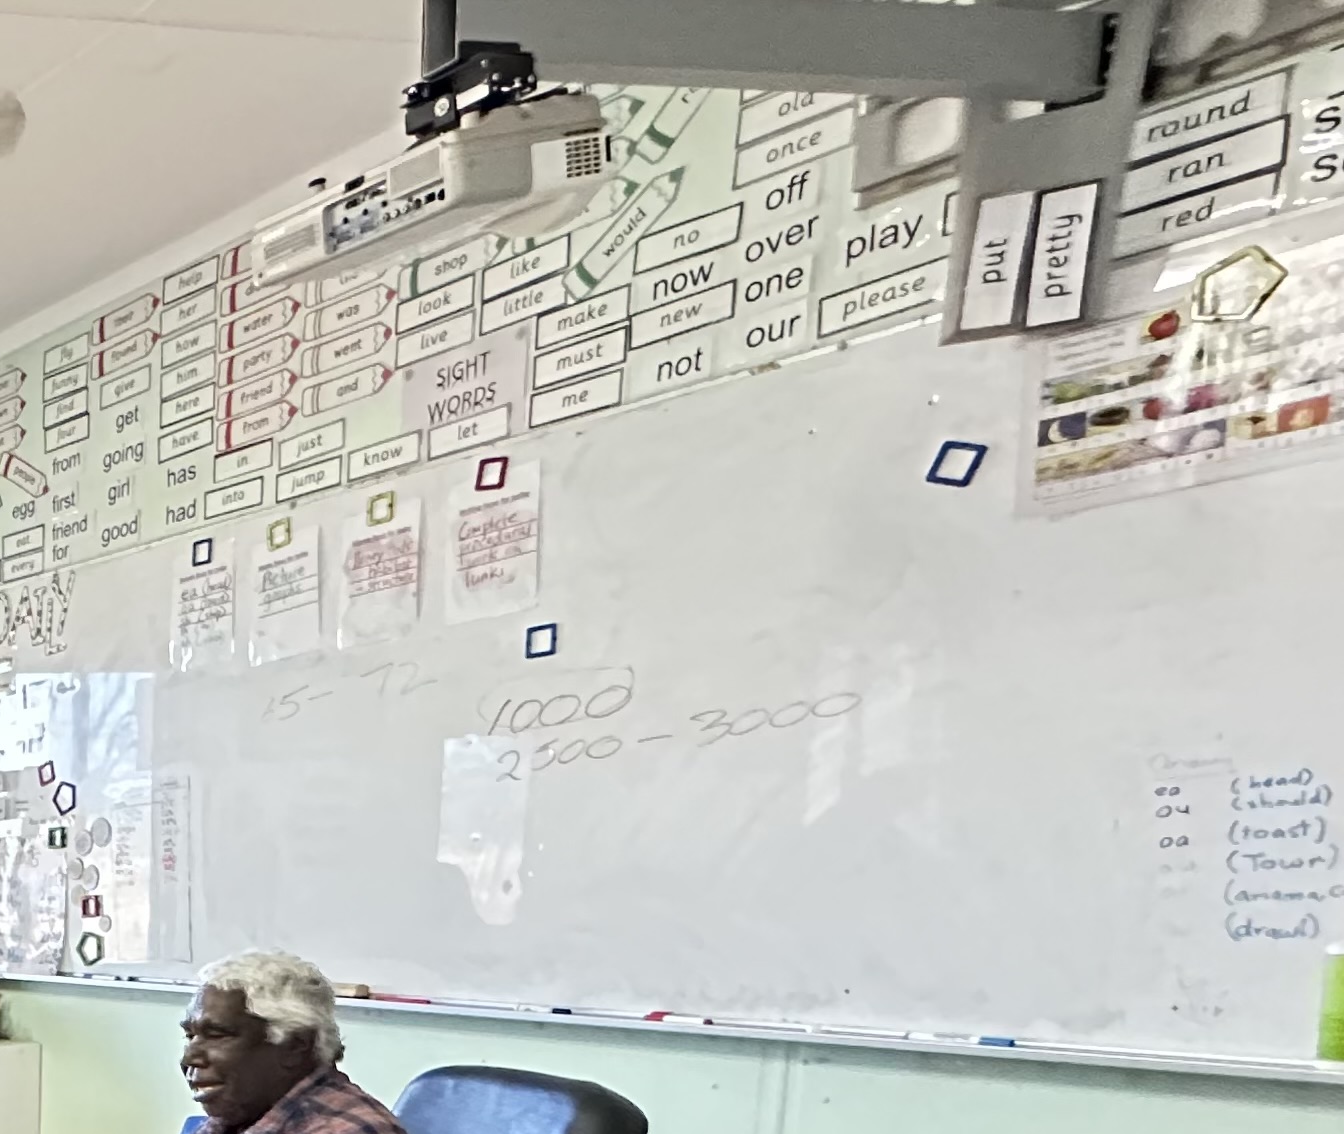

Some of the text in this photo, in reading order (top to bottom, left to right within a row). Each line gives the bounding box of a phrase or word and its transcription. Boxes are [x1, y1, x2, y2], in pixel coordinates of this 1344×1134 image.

[1147, 89, 1251, 142] round
[766, 131, 822, 163] once
[1167, 152, 1225, 183] ran
[766, 170, 811, 211] off
[1161, 196, 1216, 232] red
[602, 207, 648, 258] would
[673, 229, 700, 249] no
[745, 215, 819, 263] over
[846, 214, 923, 268] play
[434, 253, 468, 277] shop
[510, 254, 541, 280] like
[982, 238, 1007, 284] put
[1044, 213, 1083, 298] pretty
[652, 261, 714, 302] now
[745, 267, 804, 303] one
[418, 291, 452, 316] look
[503, 290, 544, 318] little
[843, 276, 926, 322] please
[557, 302, 608, 332] make
[660, 302, 702, 328] new
[420, 329, 448, 350] live
[746, 315, 801, 348] our
[436, 351, 492, 387] SIGHT
[556, 344, 604, 372] must
[657, 346, 704, 381] not
[427, 382, 496, 425] WORDS
[561, 388, 589, 408] me
[116, 405, 139, 433] get
[457, 422, 478, 442] let
[103, 442, 144, 473] going
[296, 434, 322, 457] just
[363, 445, 404, 467] know
[52, 452, 81, 475] from
[167, 465, 197, 487] has
[108, 477, 130, 506] girl
[291, 469, 325, 492] jump
[12, 501, 35, 520] egg
[52, 492, 76, 514] first
[166, 499, 197, 525] had
[52, 515, 88, 541] friend
[101, 515, 139, 547] good
[52, 544, 70, 562] for
[487, 685, 632, 736] 1000
[496, 736, 623, 782] 2500
[690, 692, 864, 747] 3000
